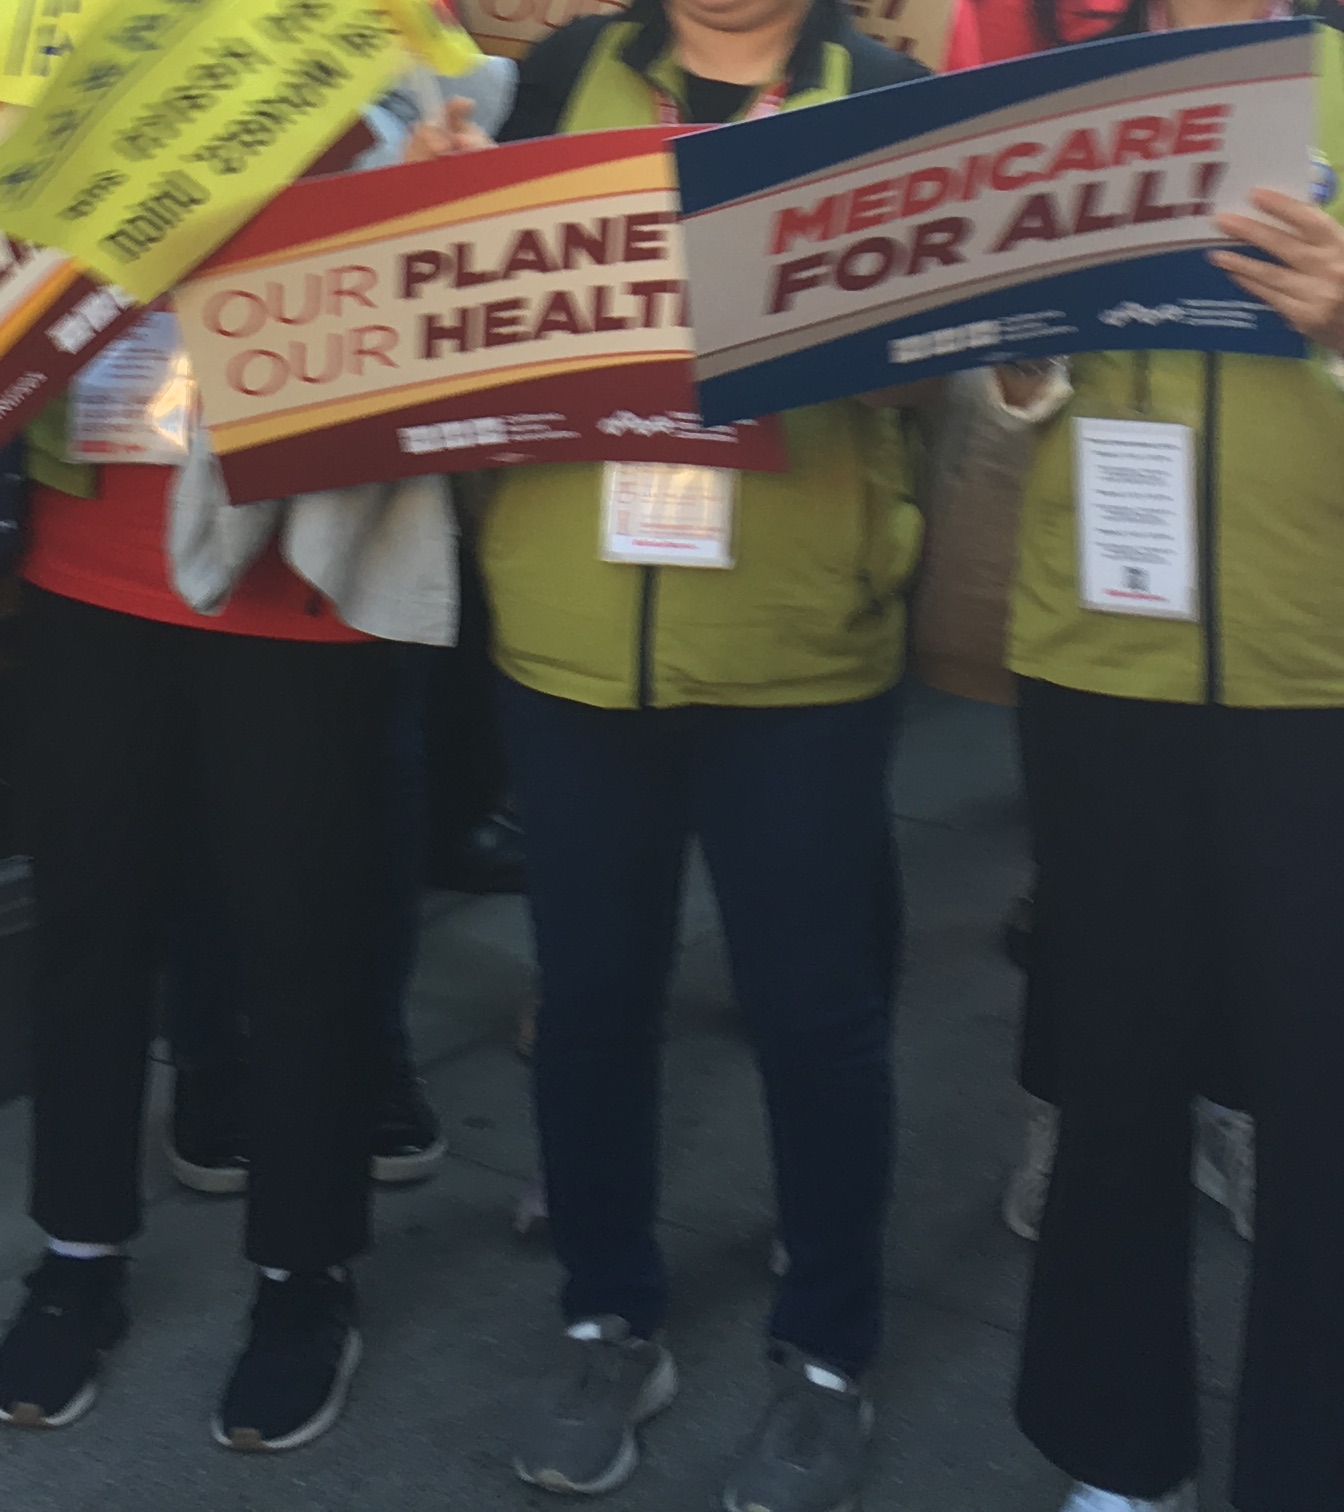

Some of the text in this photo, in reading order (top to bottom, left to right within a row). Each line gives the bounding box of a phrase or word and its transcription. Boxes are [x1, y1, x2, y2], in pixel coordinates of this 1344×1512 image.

[764, 162, 1229, 316] FOR ALL!
[768, 104, 1236, 256] MEDICARE
[202, 264, 380, 338] OUR
[395, 211, 672, 300] PLANE
[226, 324, 401, 397] OUR
